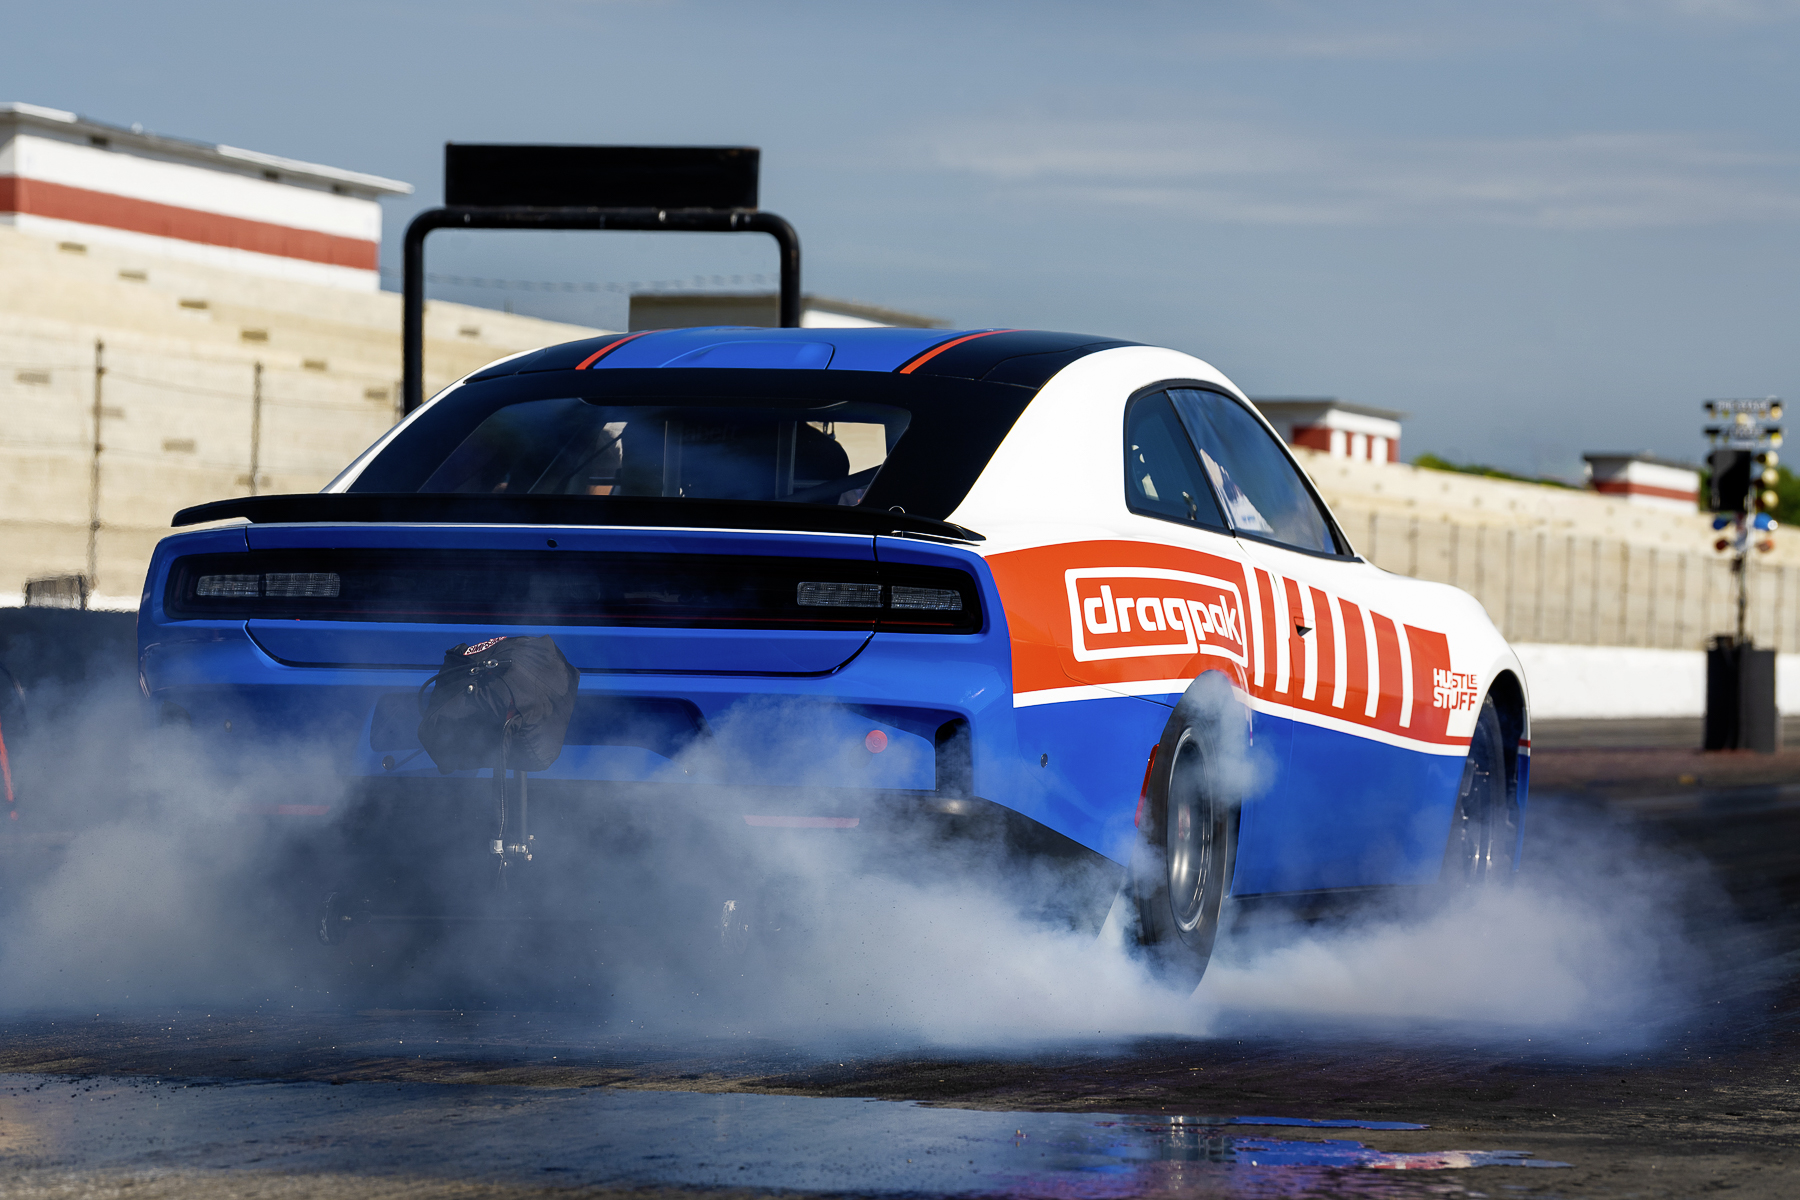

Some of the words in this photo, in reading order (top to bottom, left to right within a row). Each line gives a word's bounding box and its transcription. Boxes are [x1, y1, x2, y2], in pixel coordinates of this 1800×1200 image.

[1083, 584, 1243, 650] dragpak
[1433, 667, 1478, 690] HUSTLE
[1433, 686, 1478, 711] STUFF
